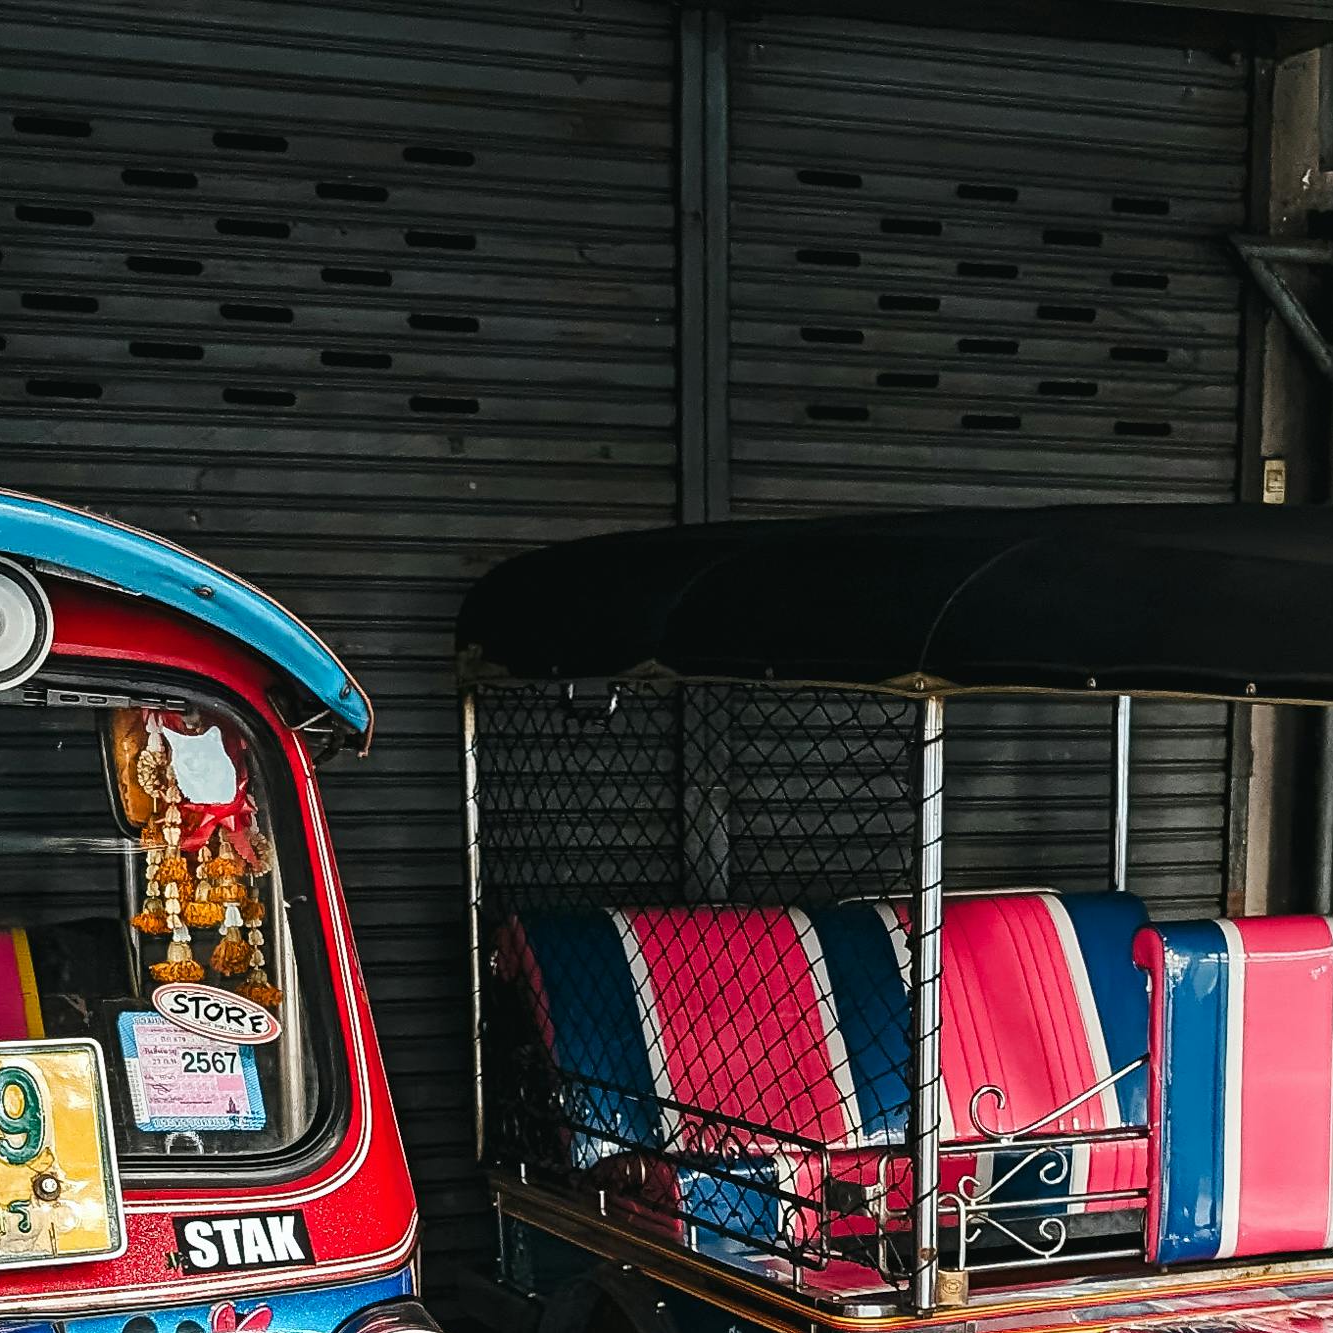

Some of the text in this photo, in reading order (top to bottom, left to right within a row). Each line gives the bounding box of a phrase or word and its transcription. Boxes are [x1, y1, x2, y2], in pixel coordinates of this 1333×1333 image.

[169, 993, 266, 1034] STORE
[181, 1051, 238, 1075] 2567
[183, 1215, 306, 1268] STAK
